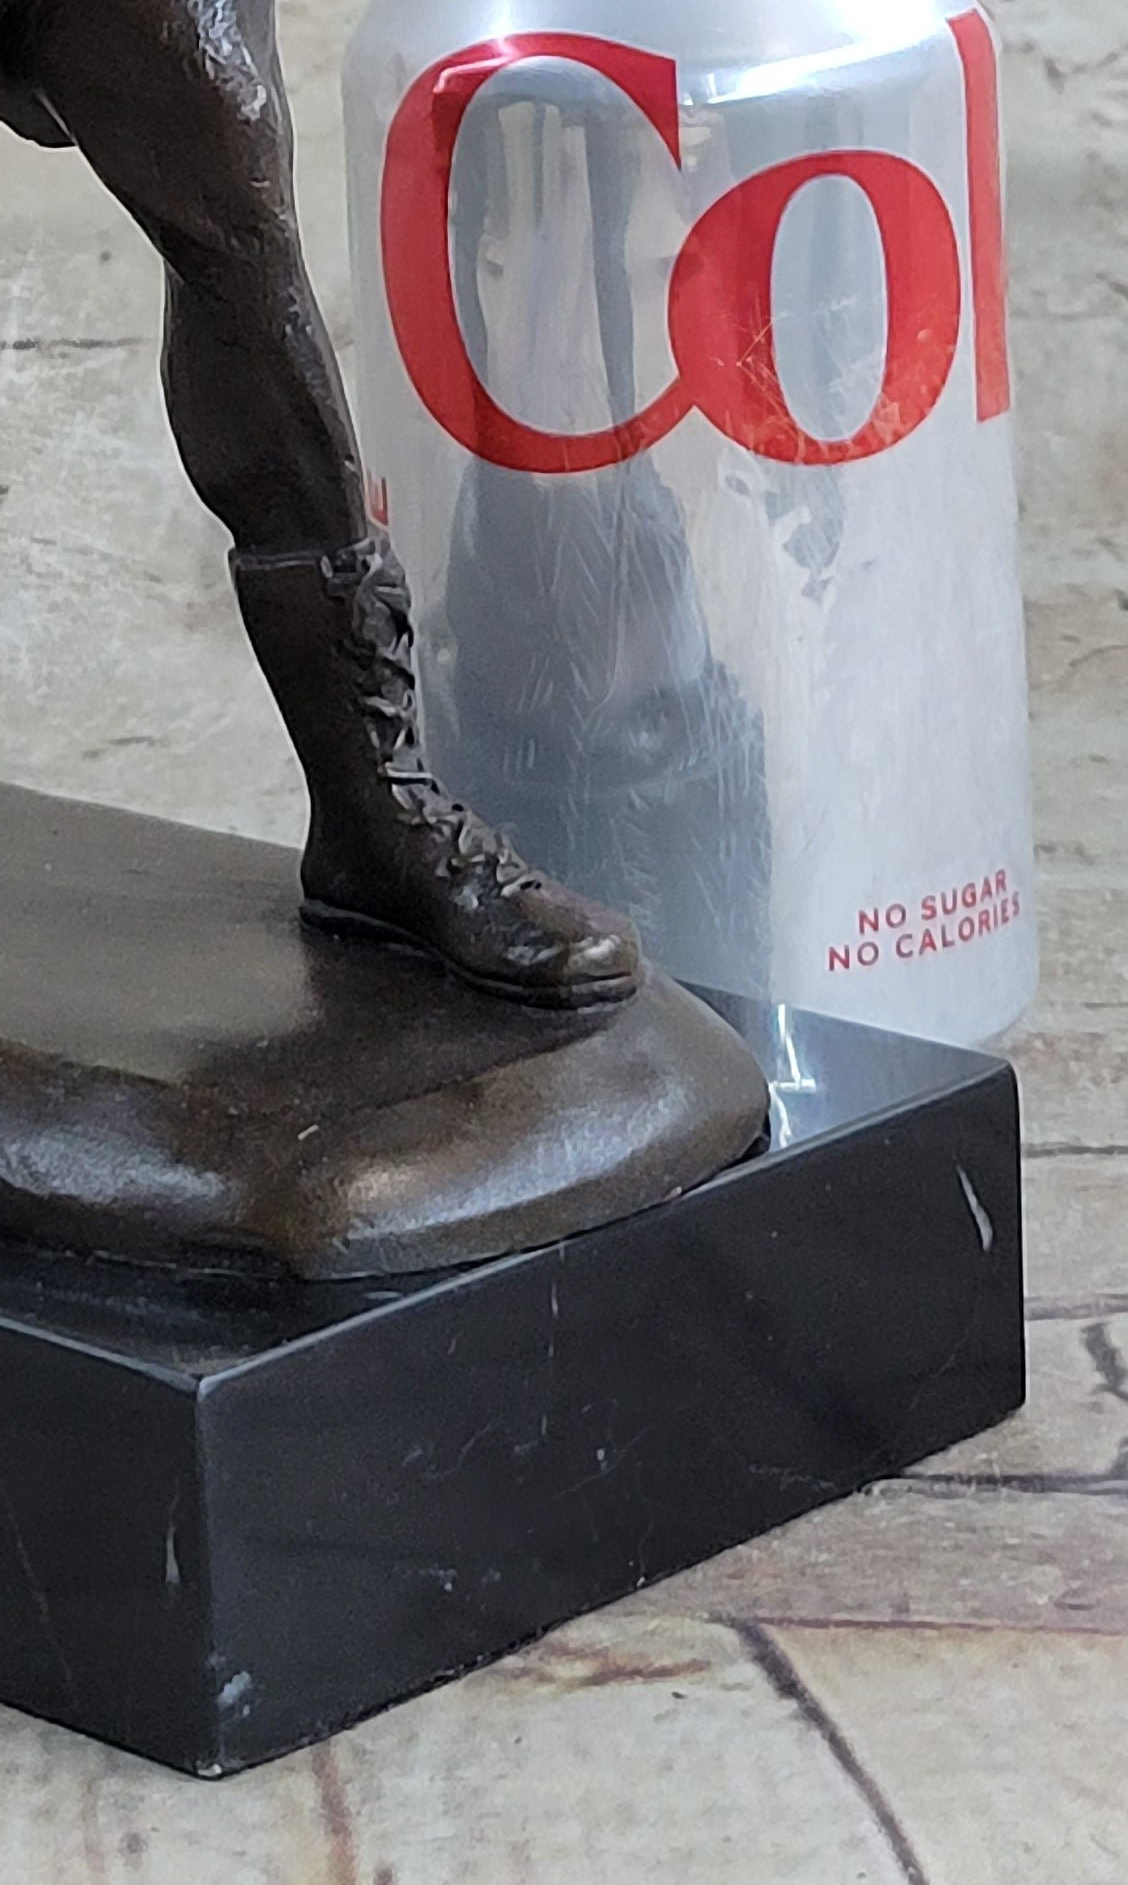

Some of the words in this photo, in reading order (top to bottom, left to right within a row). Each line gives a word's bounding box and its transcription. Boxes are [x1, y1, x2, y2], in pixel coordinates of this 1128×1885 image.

[828, 941, 880, 972] NO
[895, 890, 1021, 959] CALORIES
[858, 903, 907, 935] NO
[921, 868, 1007, 921] SUGAR
